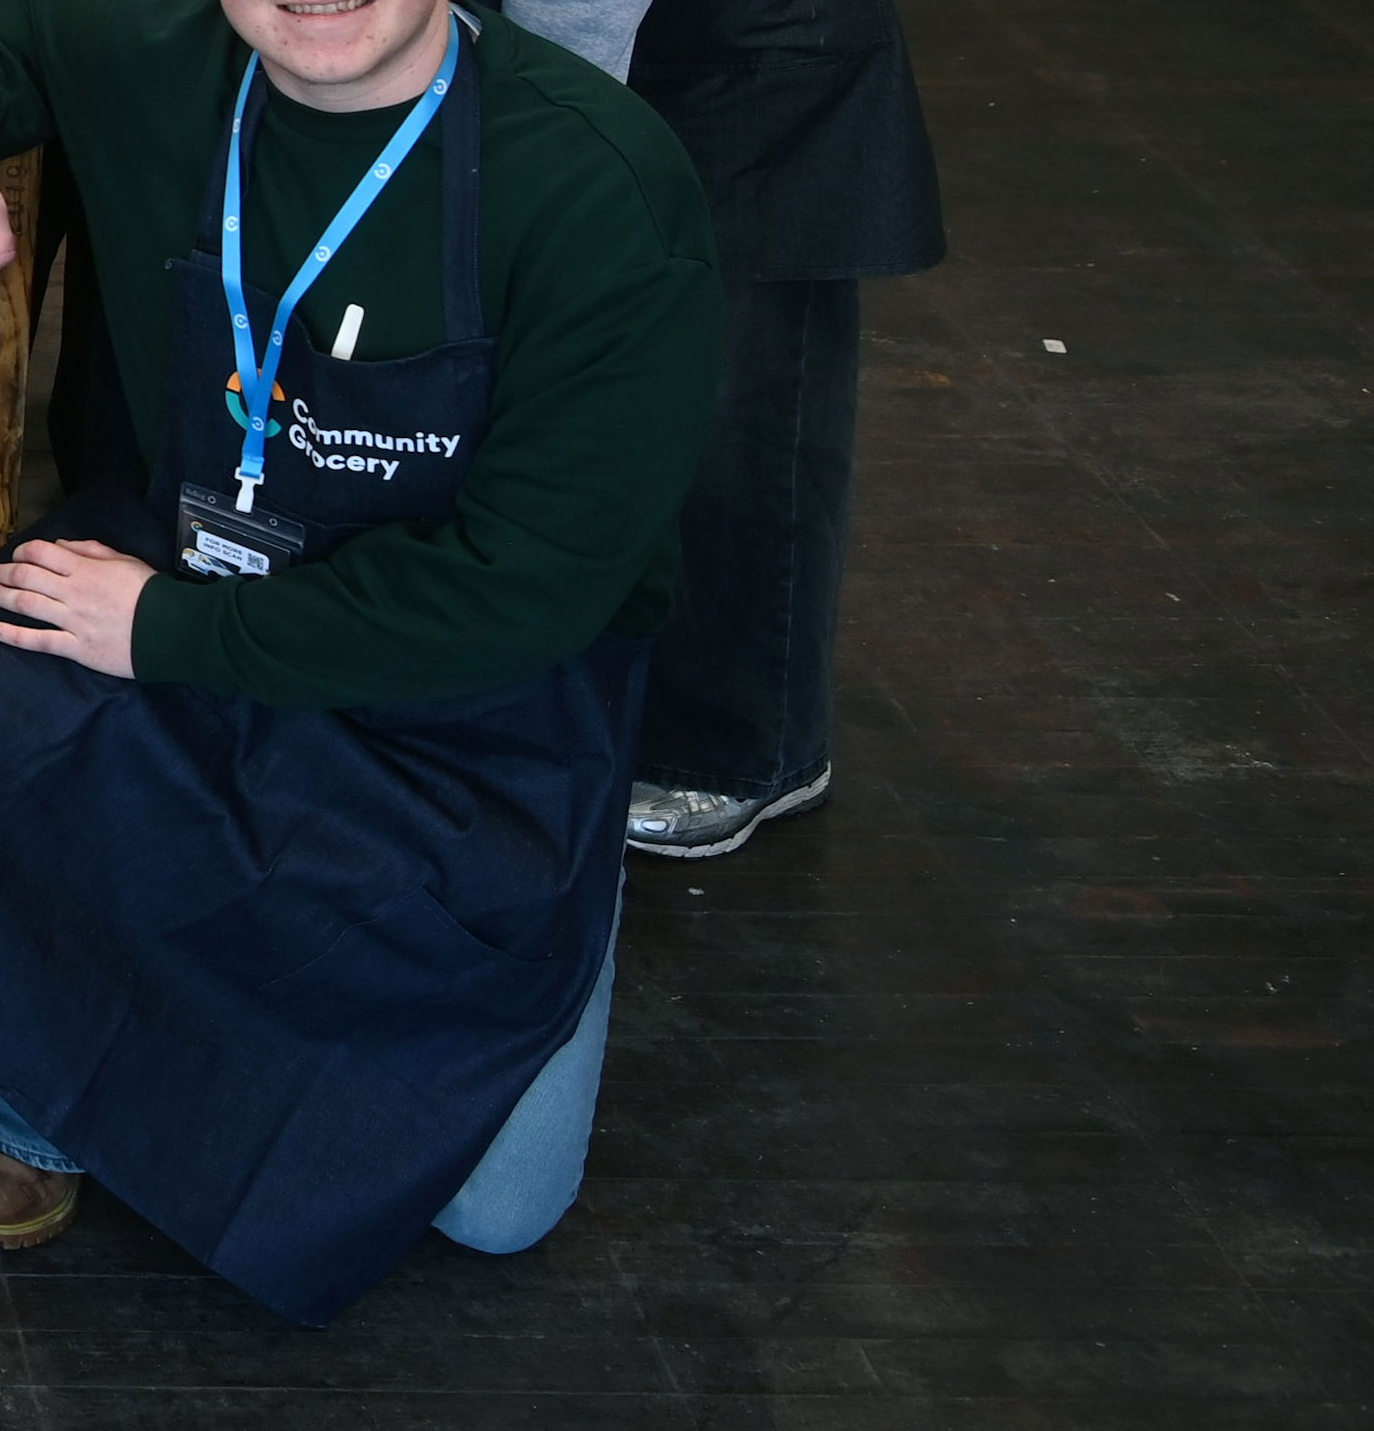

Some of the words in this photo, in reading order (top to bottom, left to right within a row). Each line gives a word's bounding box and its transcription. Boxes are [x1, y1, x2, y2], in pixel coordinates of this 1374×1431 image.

[292, 397, 461, 458] Community
[288, 423, 400, 481] Grocery
[205, 536, 220, 547] FOR
[221, 542, 243, 556] MORE
[223, 549, 243, 562] SCAN
